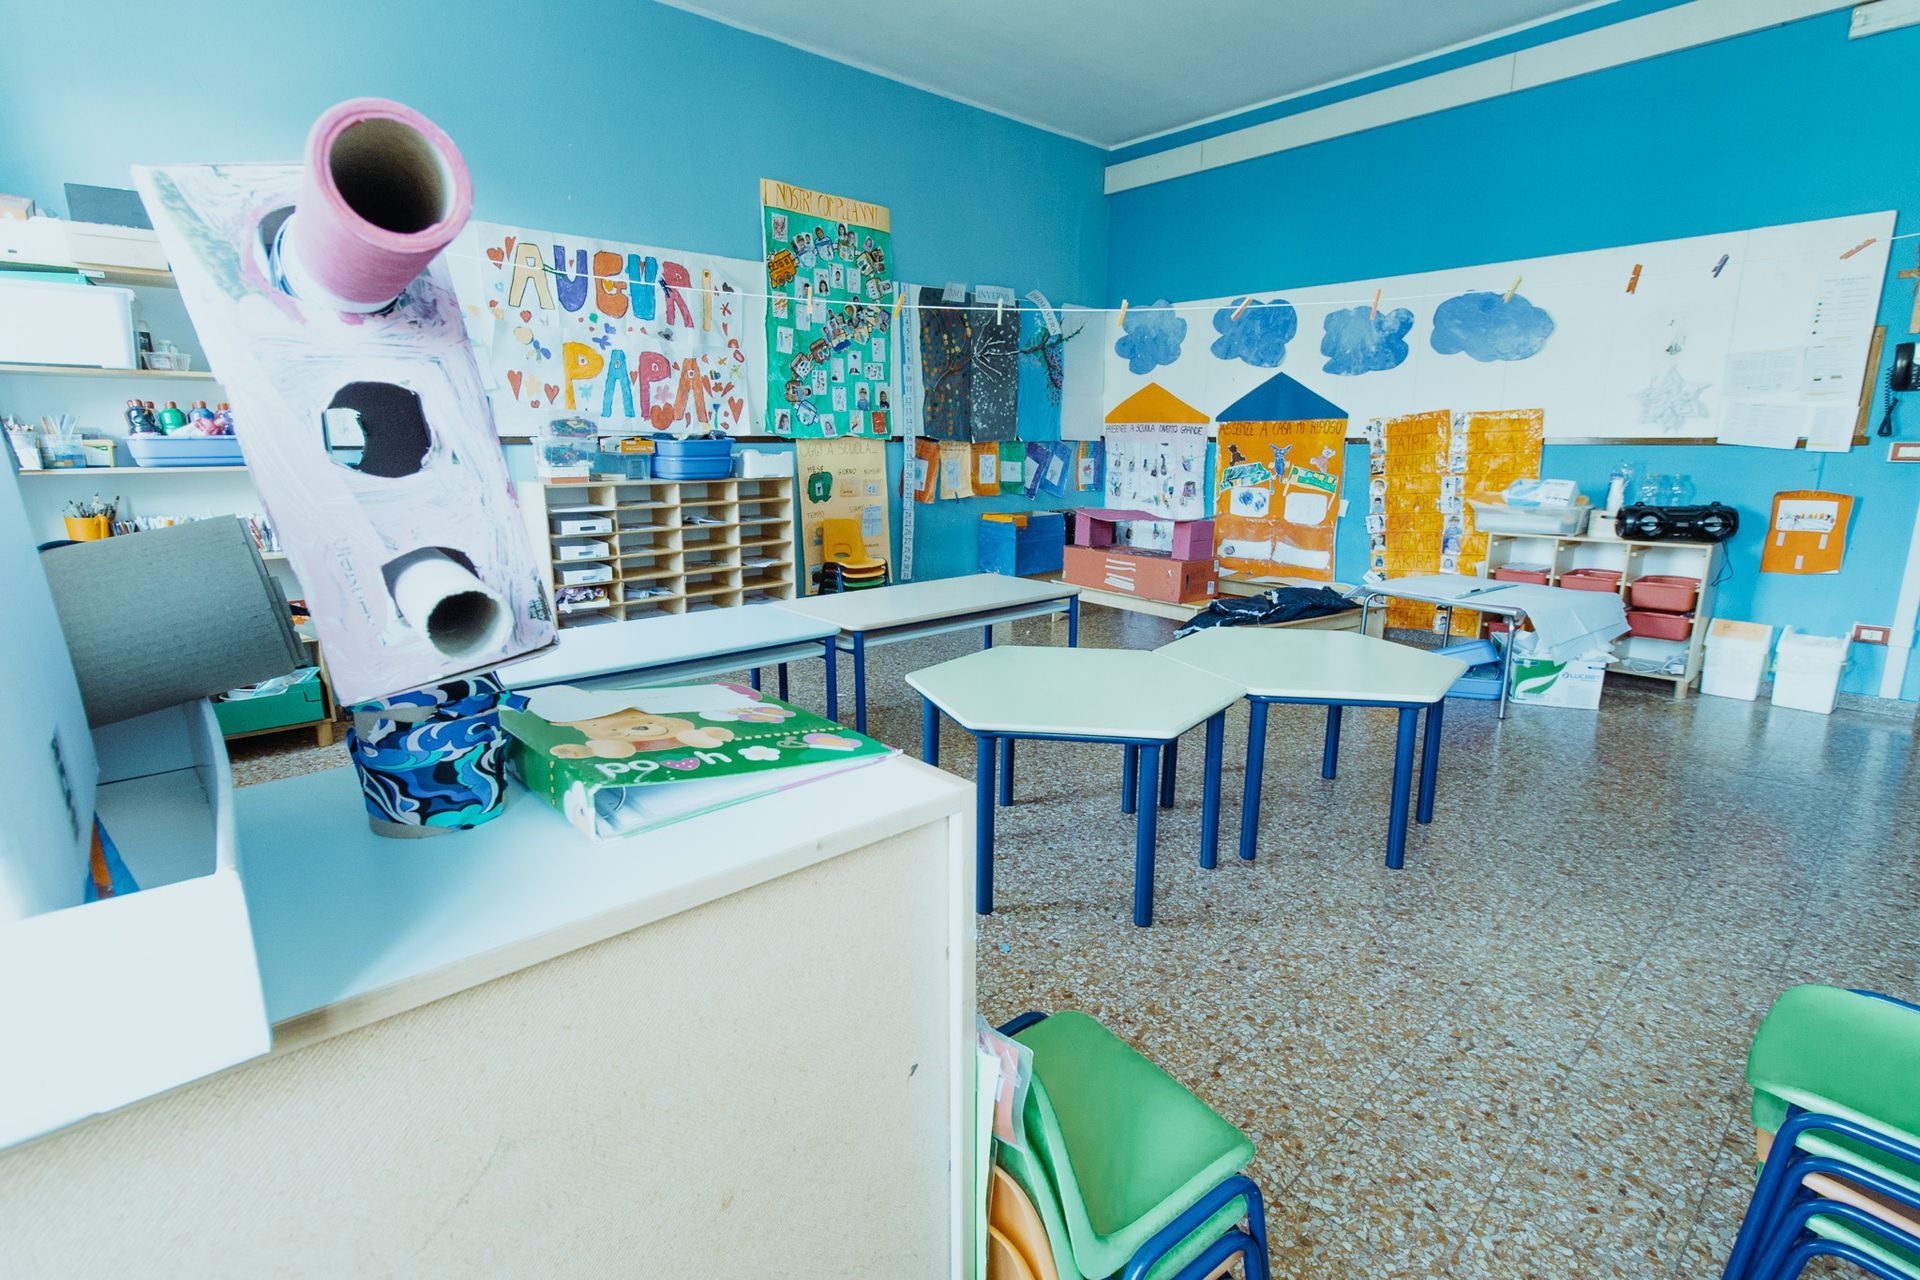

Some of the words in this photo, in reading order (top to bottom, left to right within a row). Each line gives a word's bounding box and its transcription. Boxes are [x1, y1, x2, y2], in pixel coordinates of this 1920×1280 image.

[776, 183, 813, 213] NOSTRI
[508, 242, 713, 332] AUGURI
[1136, 424, 1155, 433] SCUOLA
[1260, 422, 1268, 436] A
[1272, 421, 1292, 436] CASA
[1310, 419, 1342, 435] RIPOSO
[827, 440, 834, 456] A
[807, 465, 824, 474] MESE
